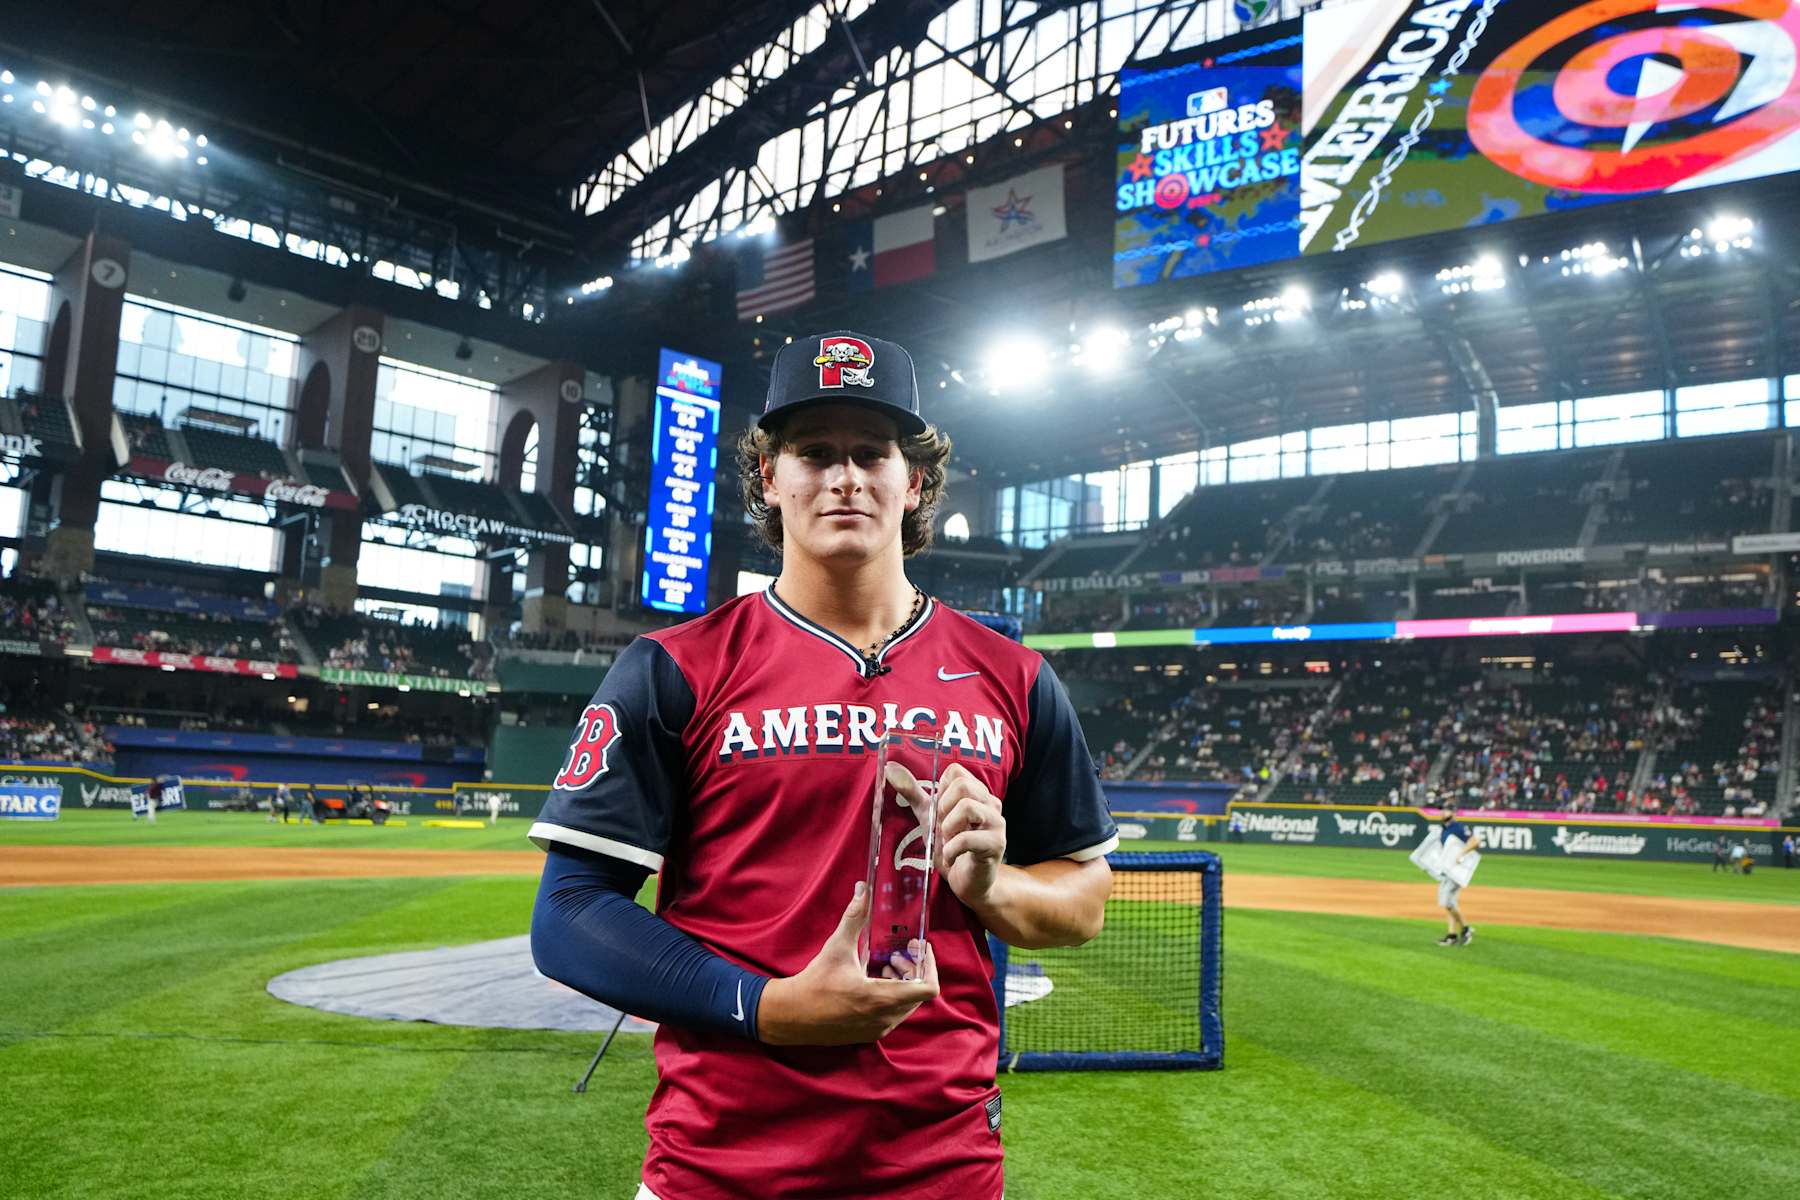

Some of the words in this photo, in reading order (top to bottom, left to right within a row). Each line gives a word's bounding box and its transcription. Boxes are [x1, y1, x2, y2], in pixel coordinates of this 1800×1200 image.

[1140, 99, 1276, 154] FUTURES
[1300, 0, 1474, 251] MERICA
[1154, 131, 1259, 177] SKILLS
[1116, 147, 1299, 211] SHOWCASE
[104, 263, 117, 281] 7
[413, 504, 505, 535] CHOCTAW
[1496, 547, 1585, 566] POWERADE
[1071, 573, 1143, 591] DALLAS
[338, 668, 400, 688] LUXOR
[403, 674, 487, 696] STAFFING
[553, 703, 622, 791] B
[717, 703, 1003, 764] AMERICAN
[1249, 814, 1318, 832] National
[1359, 812, 1416, 846] Kroger
